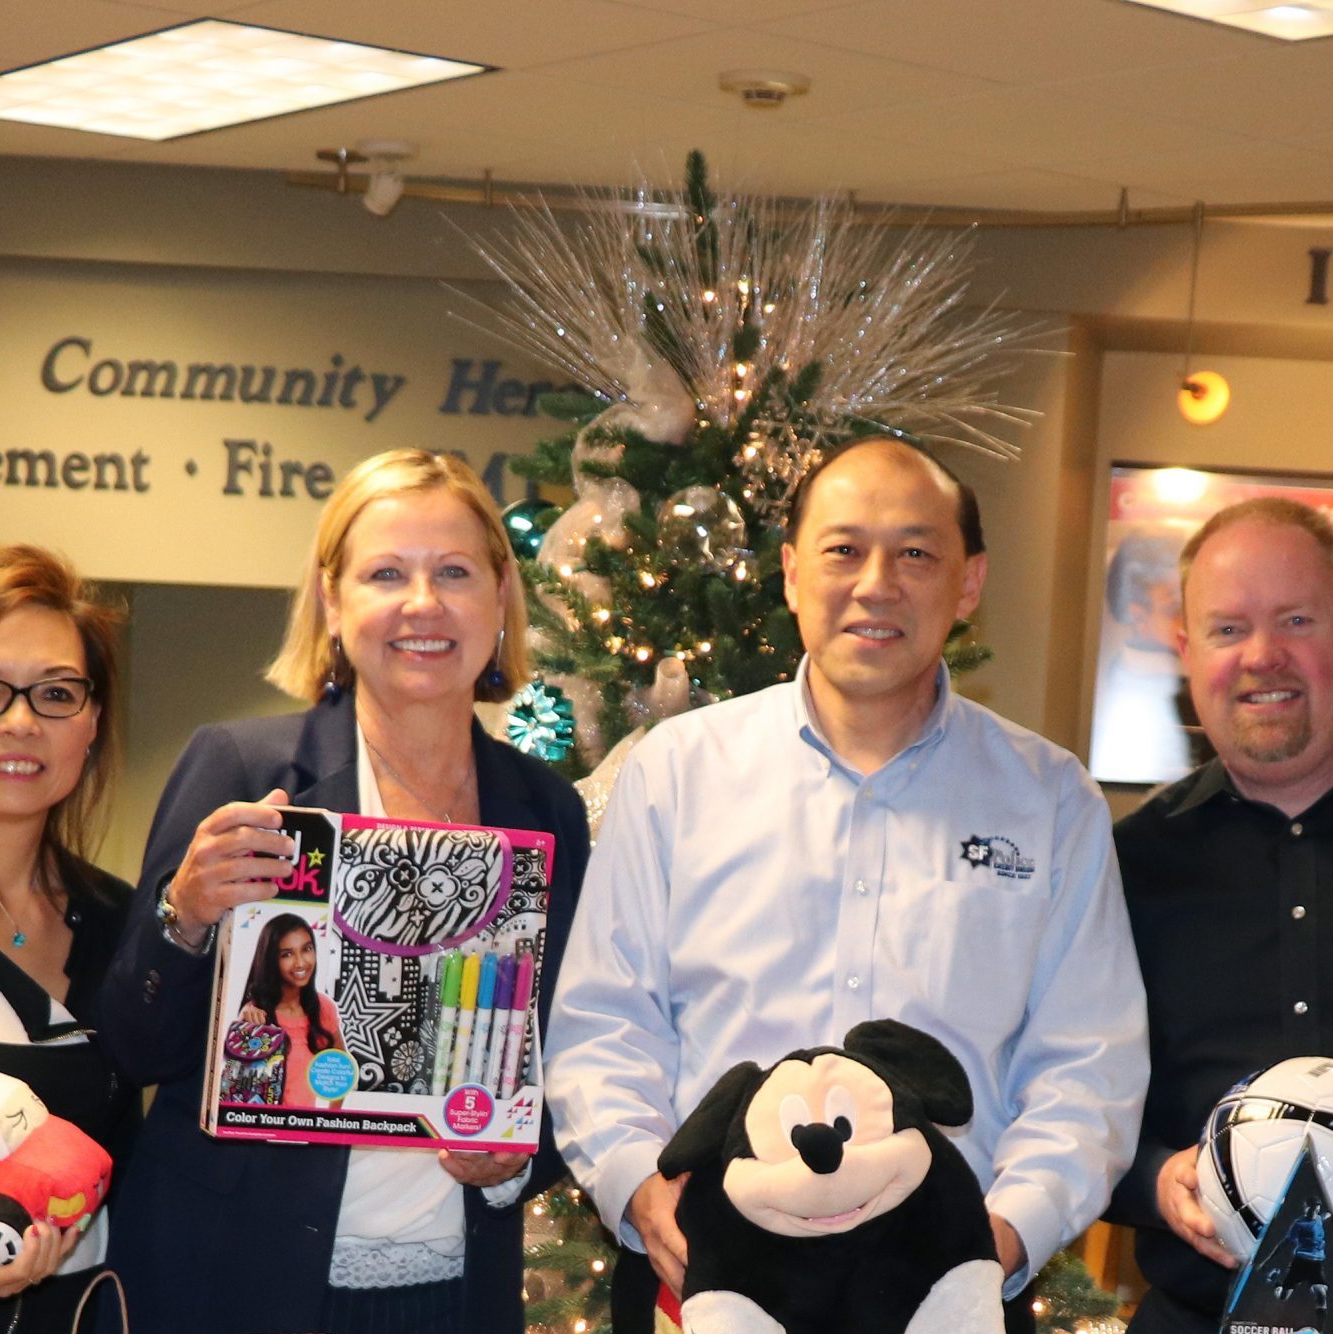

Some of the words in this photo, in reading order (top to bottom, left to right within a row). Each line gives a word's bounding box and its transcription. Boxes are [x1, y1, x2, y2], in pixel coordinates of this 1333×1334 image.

[40, 335, 406, 422] Community
[220, 437, 335, 500] Fire
[967, 844, 989, 860] SF
[465, 1095, 477, 1110] 5
[226, 1112, 257, 1124] Color
[260, 1114, 285, 1126] Your
[288, 1115, 313, 1127] Own
[316, 1117, 360, 1130] Fashion
[362, 1120, 417, 1133] Backpack
